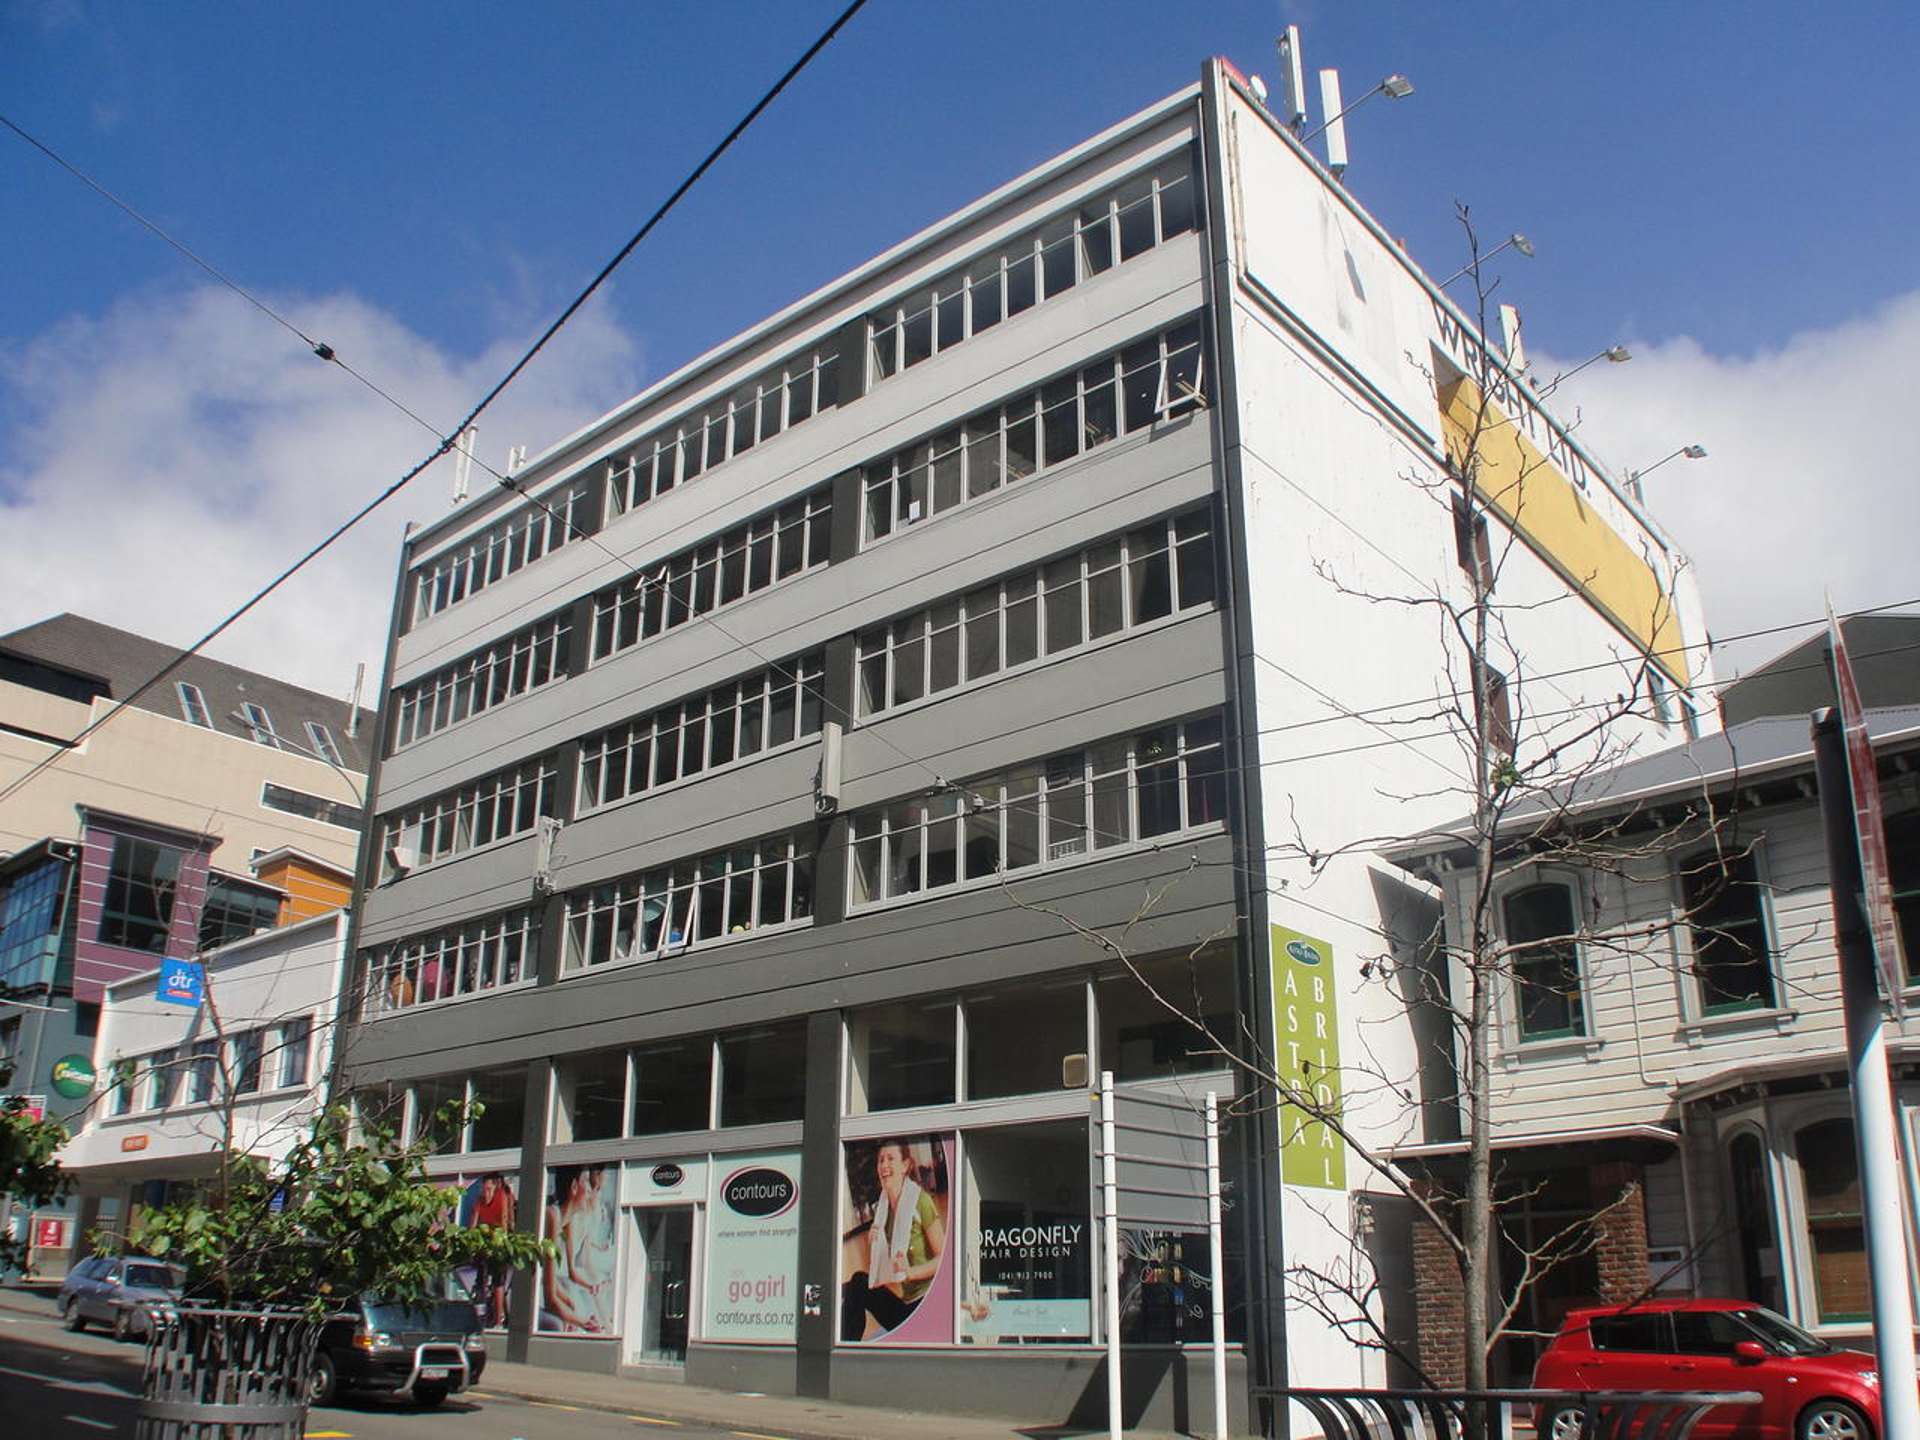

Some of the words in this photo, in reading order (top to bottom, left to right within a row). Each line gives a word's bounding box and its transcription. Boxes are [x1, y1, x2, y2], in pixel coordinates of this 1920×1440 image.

[1313, 975, 1334, 1186] BRIDAL
[731, 1182, 787, 1200] contours
[980, 1247, 1011, 1260] HAIR
[1019, 1245, 1072, 1259] DESIGN
[728, 1280, 752, 1304] go
[755, 1274, 786, 1305] girl
[716, 1311, 795, 1326] contours.co.nz
